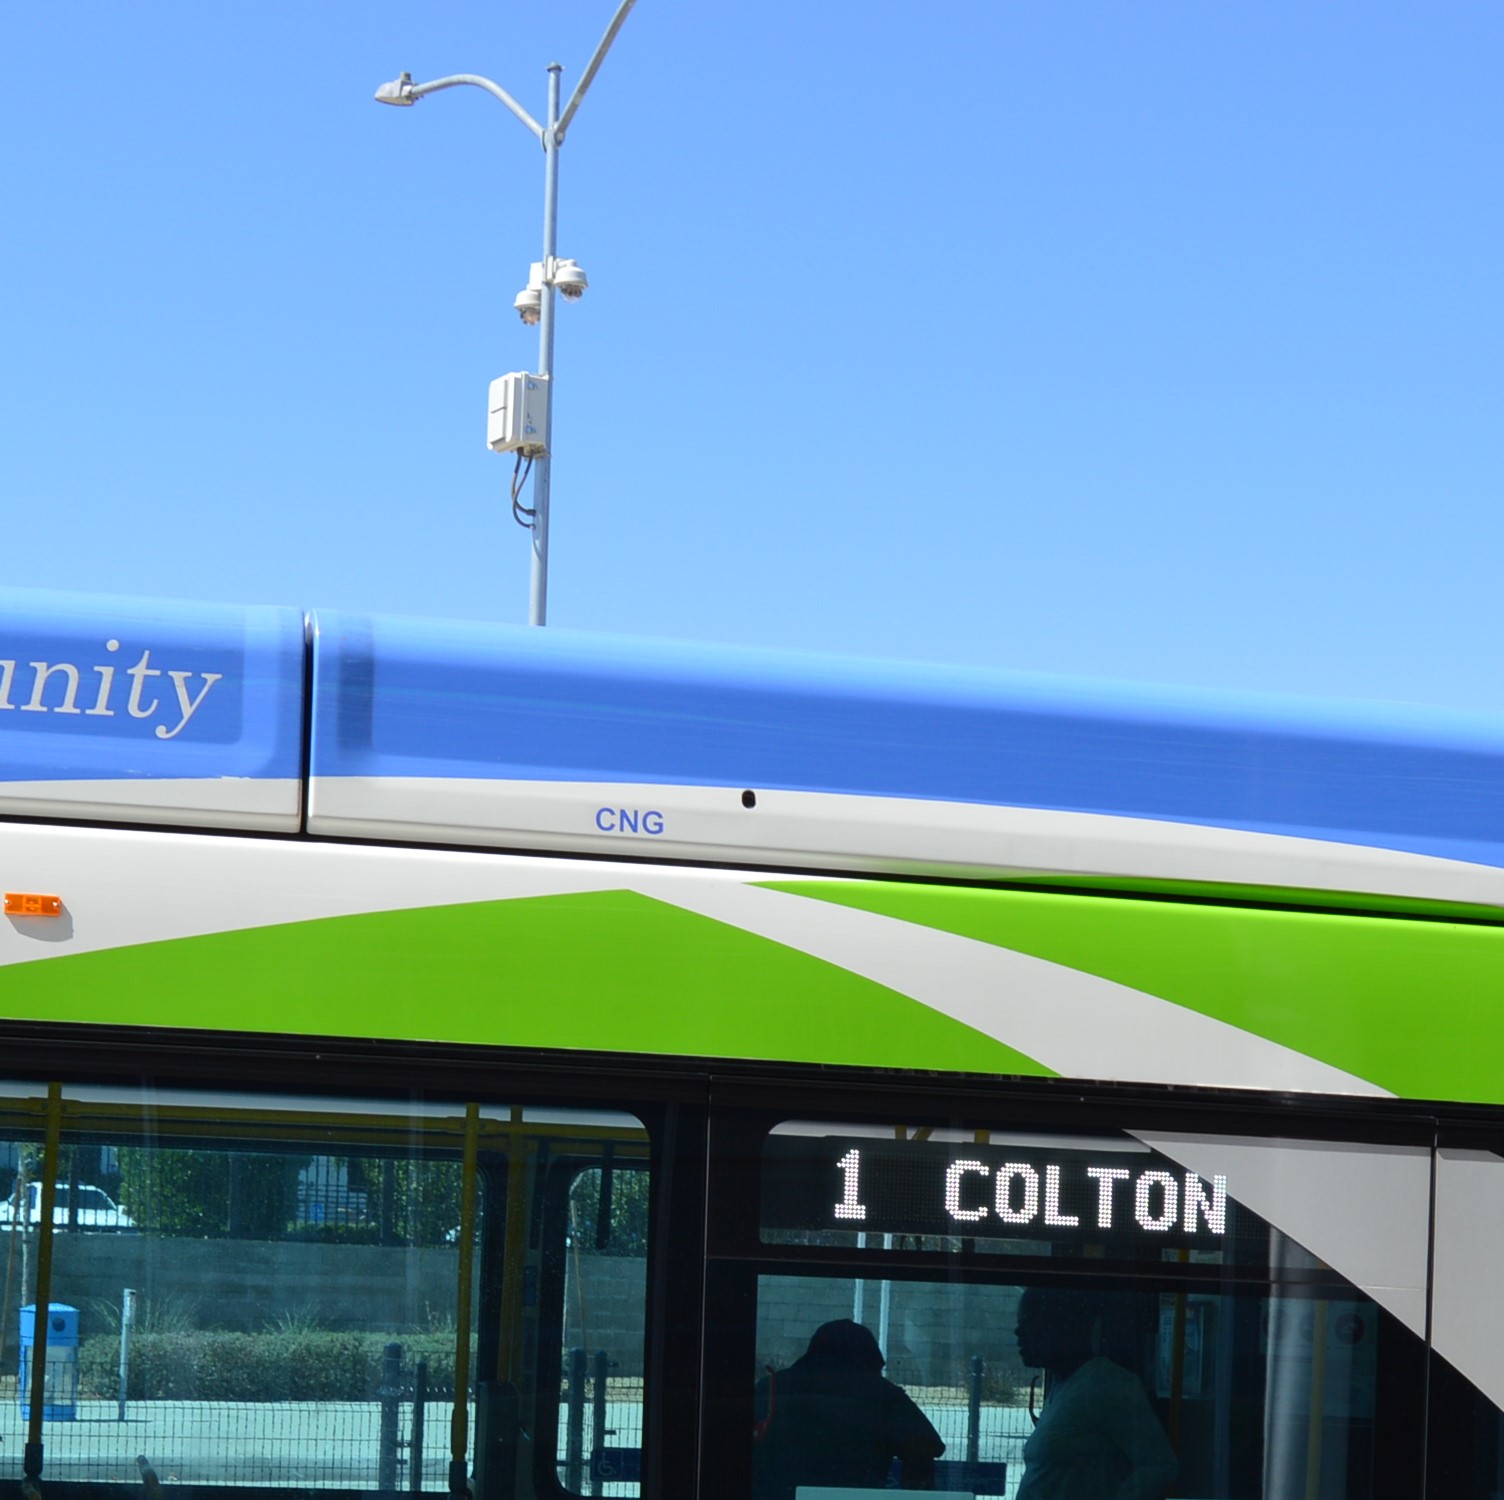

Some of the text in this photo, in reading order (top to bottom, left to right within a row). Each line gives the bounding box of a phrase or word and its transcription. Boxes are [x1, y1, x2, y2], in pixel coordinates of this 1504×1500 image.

[595, 807, 665, 835] CNG
[834, 1149, 1228, 1234] 1 COLTON
